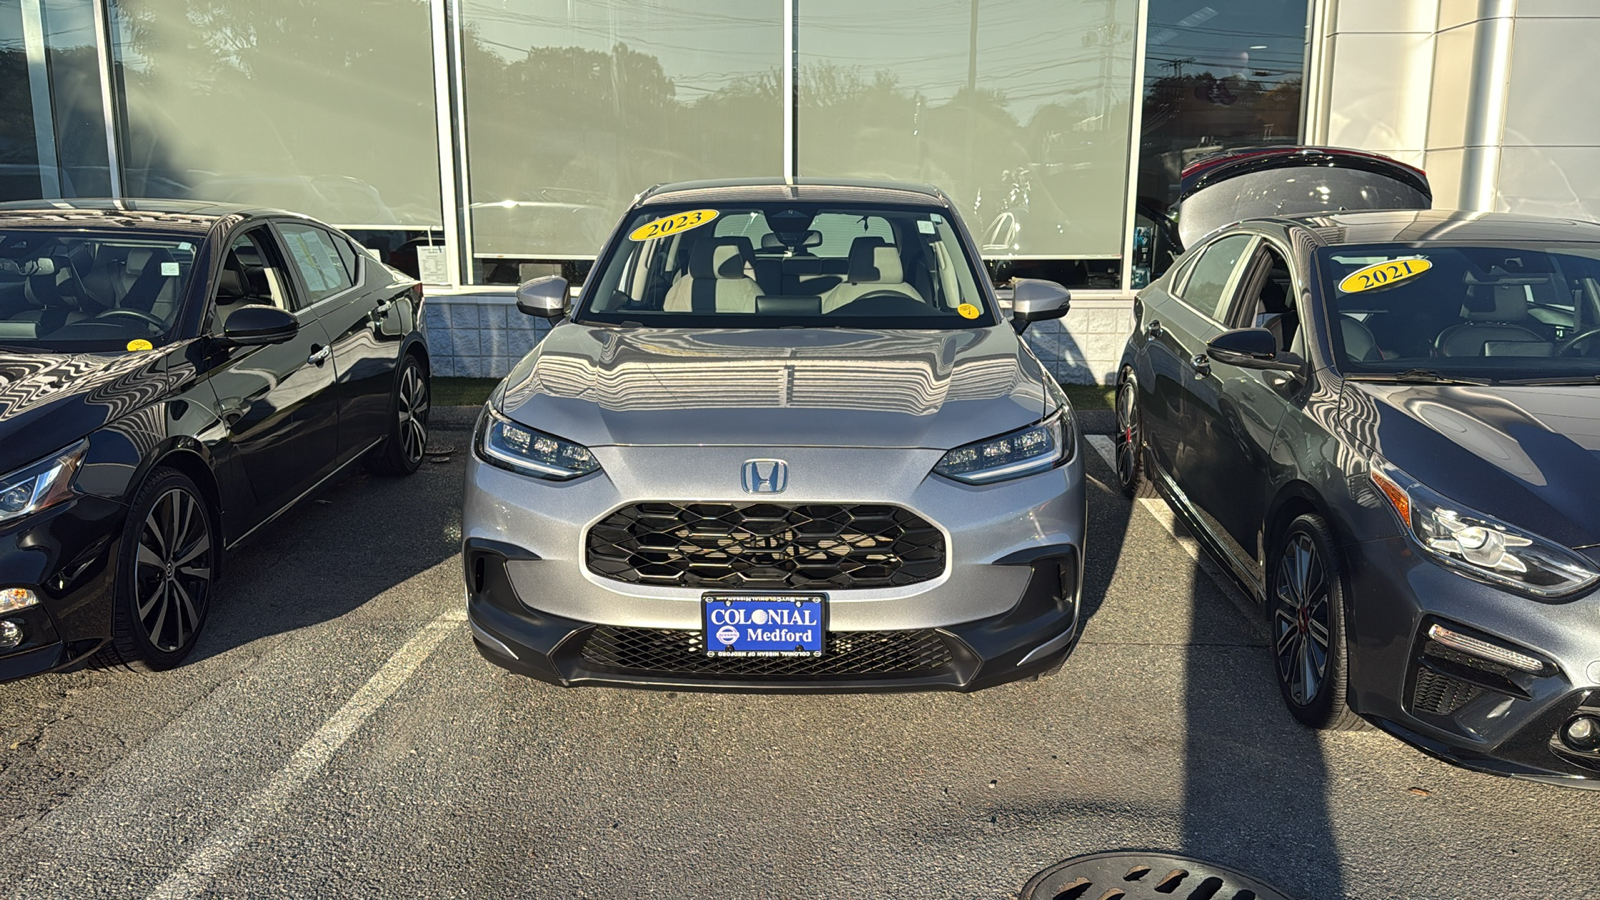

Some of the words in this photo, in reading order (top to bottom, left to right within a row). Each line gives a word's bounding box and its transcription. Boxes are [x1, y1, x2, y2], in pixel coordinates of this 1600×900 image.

[646, 212, 702, 238] 2023
[1358, 261, 1414, 288] 2021
[711, 609, 817, 625] COLONIAL
[747, 628, 812, 642] Medford
